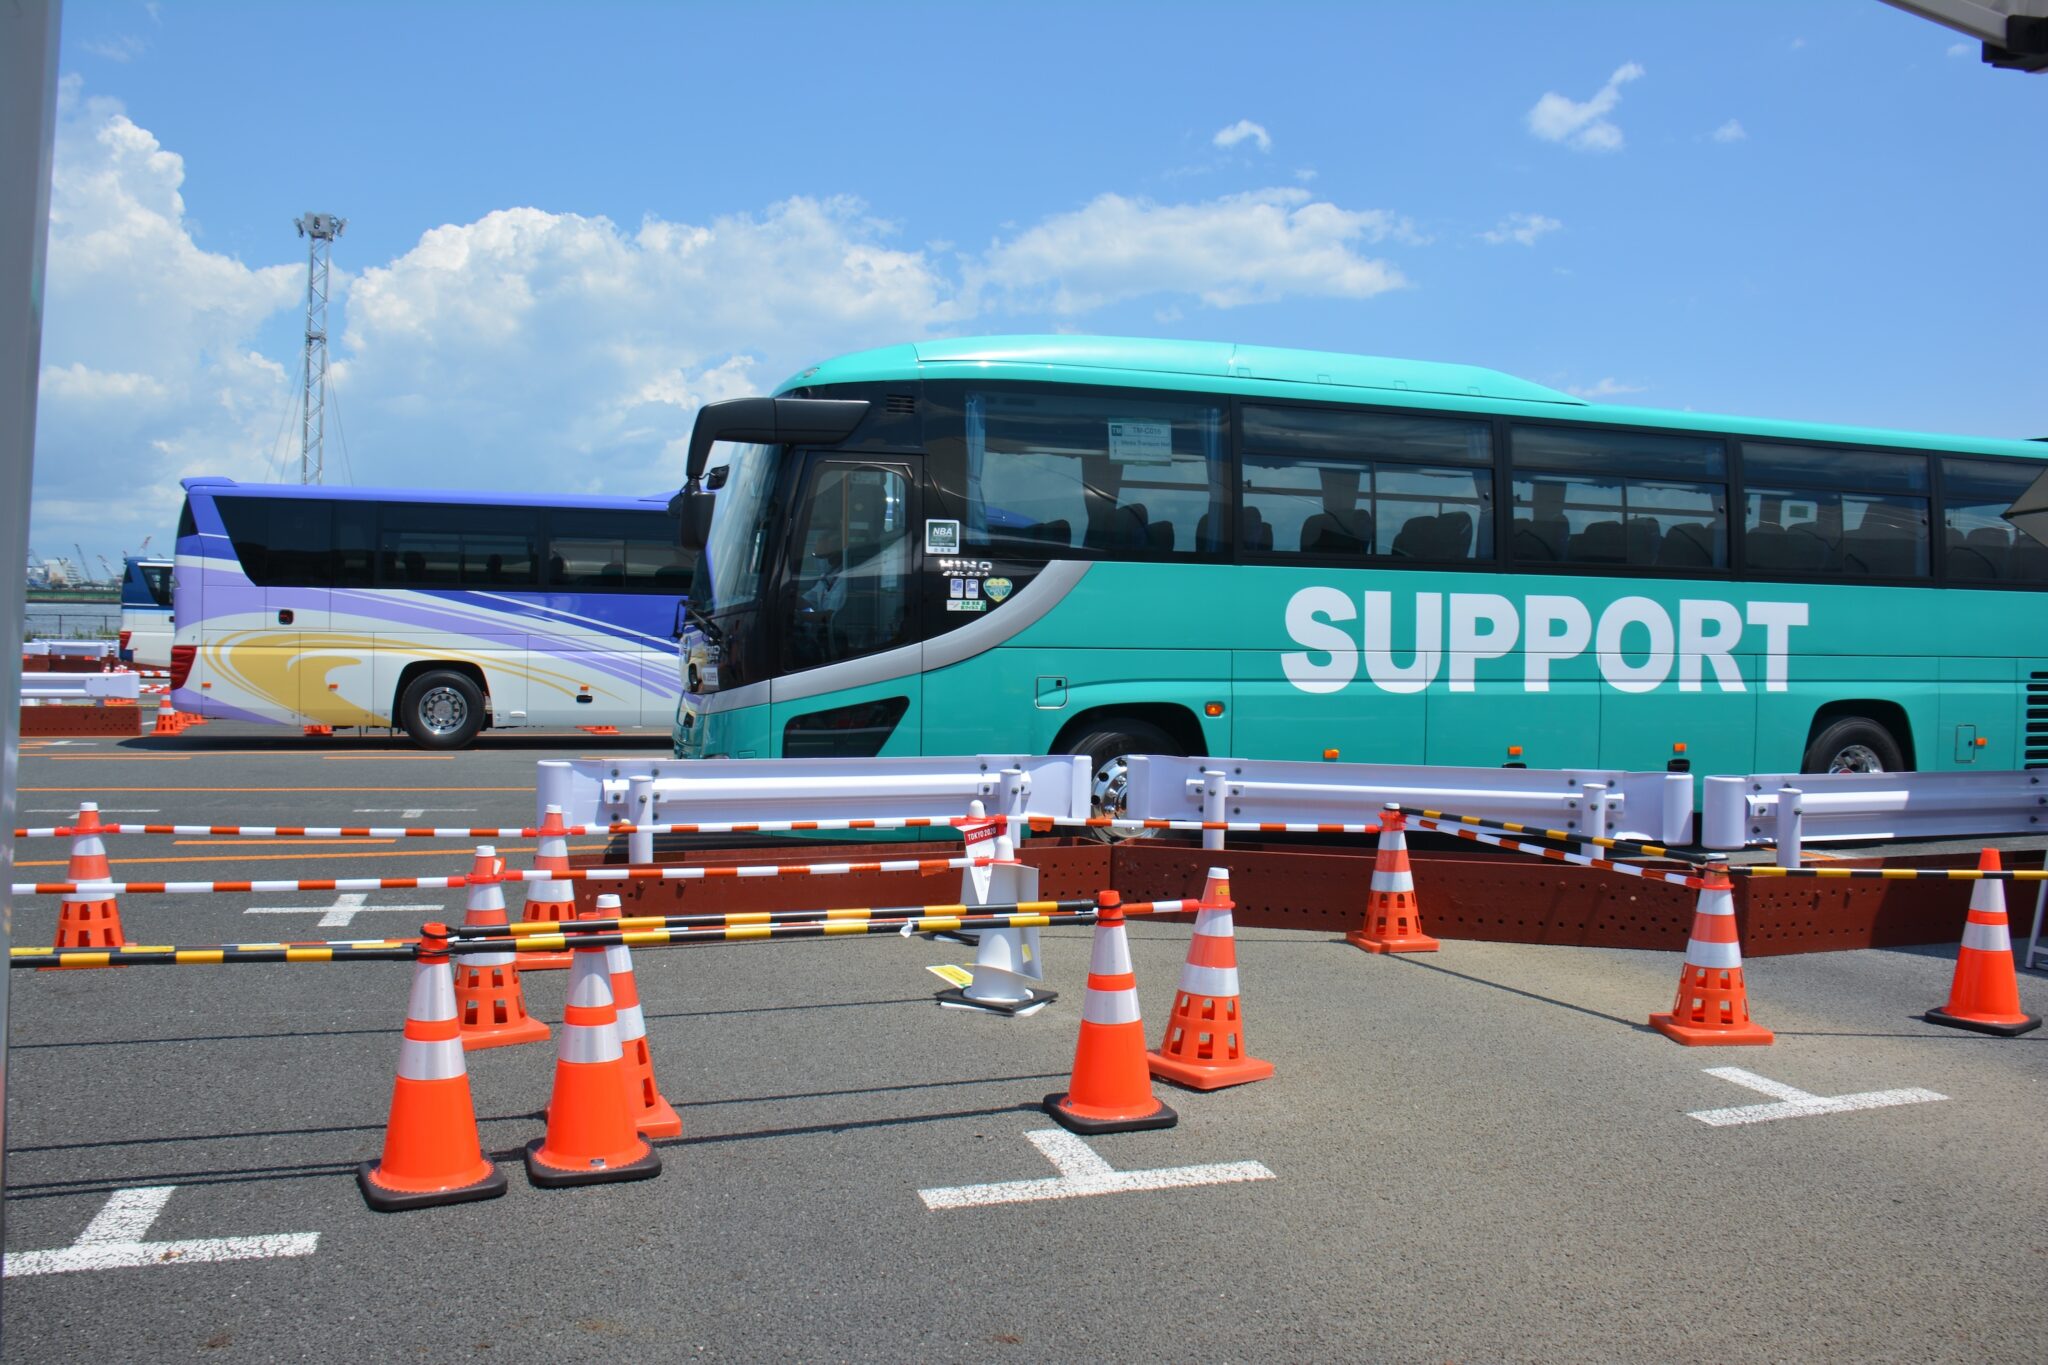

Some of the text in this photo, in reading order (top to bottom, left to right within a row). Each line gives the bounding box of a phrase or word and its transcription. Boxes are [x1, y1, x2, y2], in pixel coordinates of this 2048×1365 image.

[932, 527, 953, 536] NBA
[939, 559, 993, 570] HINO
[1280, 586, 1809, 694] SUPPORT
[967, 826, 997, 841] TOKYO 2020
